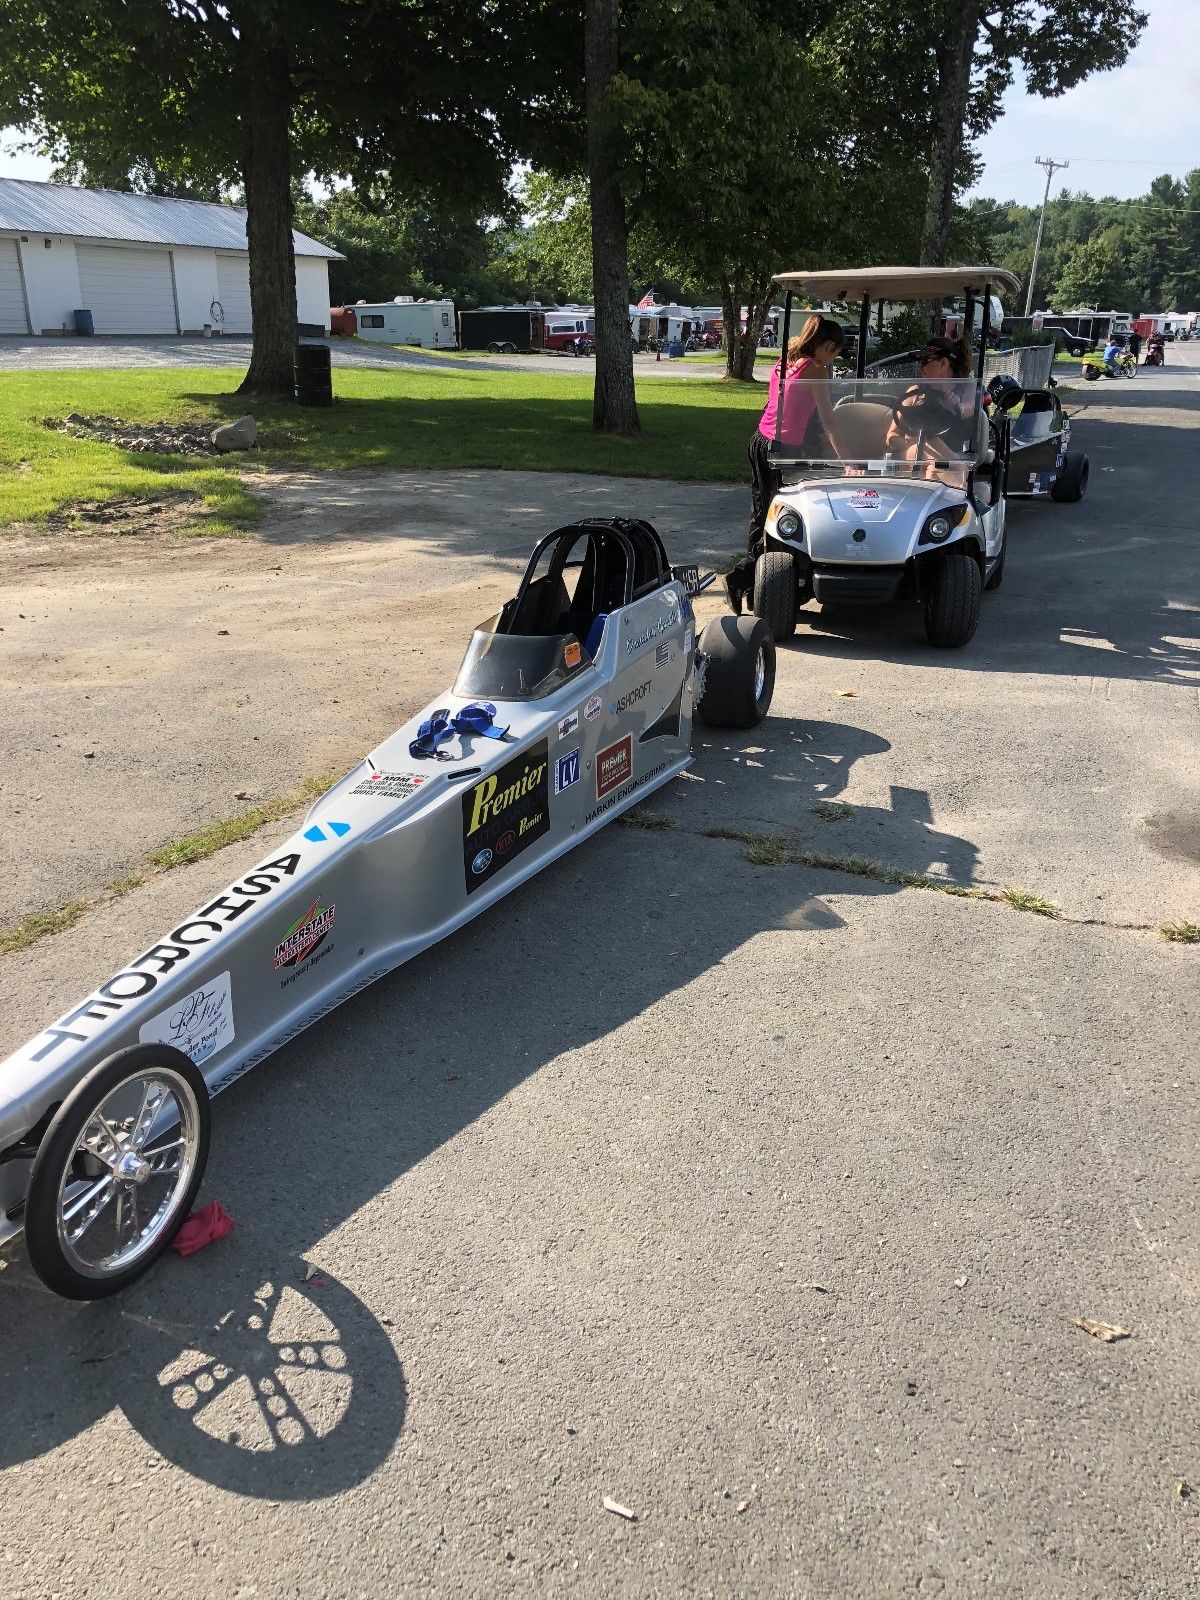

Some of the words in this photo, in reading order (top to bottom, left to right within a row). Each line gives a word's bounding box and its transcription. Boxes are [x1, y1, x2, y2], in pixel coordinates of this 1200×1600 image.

[615, 680, 652, 714] ASHCROFT
[562, 757, 577, 788] LV
[601, 749, 627, 776] PREMIER
[377, 791, 408, 799] FAMILY
[466, 762, 547, 837] Premier
[584, 796, 617, 824] HARKIN
[618, 763, 665, 801] ENGINEERING
[518, 812, 543, 837] Premier
[274, 904, 335, 958] INTERSTATE
[288, 938, 313, 958] BATTERY
[313, 921, 335, 939] CENTER
[29, 853, 301, 1062] ASHCROFT
[201, 1027, 217, 1046] Pond
[207, 1049, 269, 1097] ARKIN
